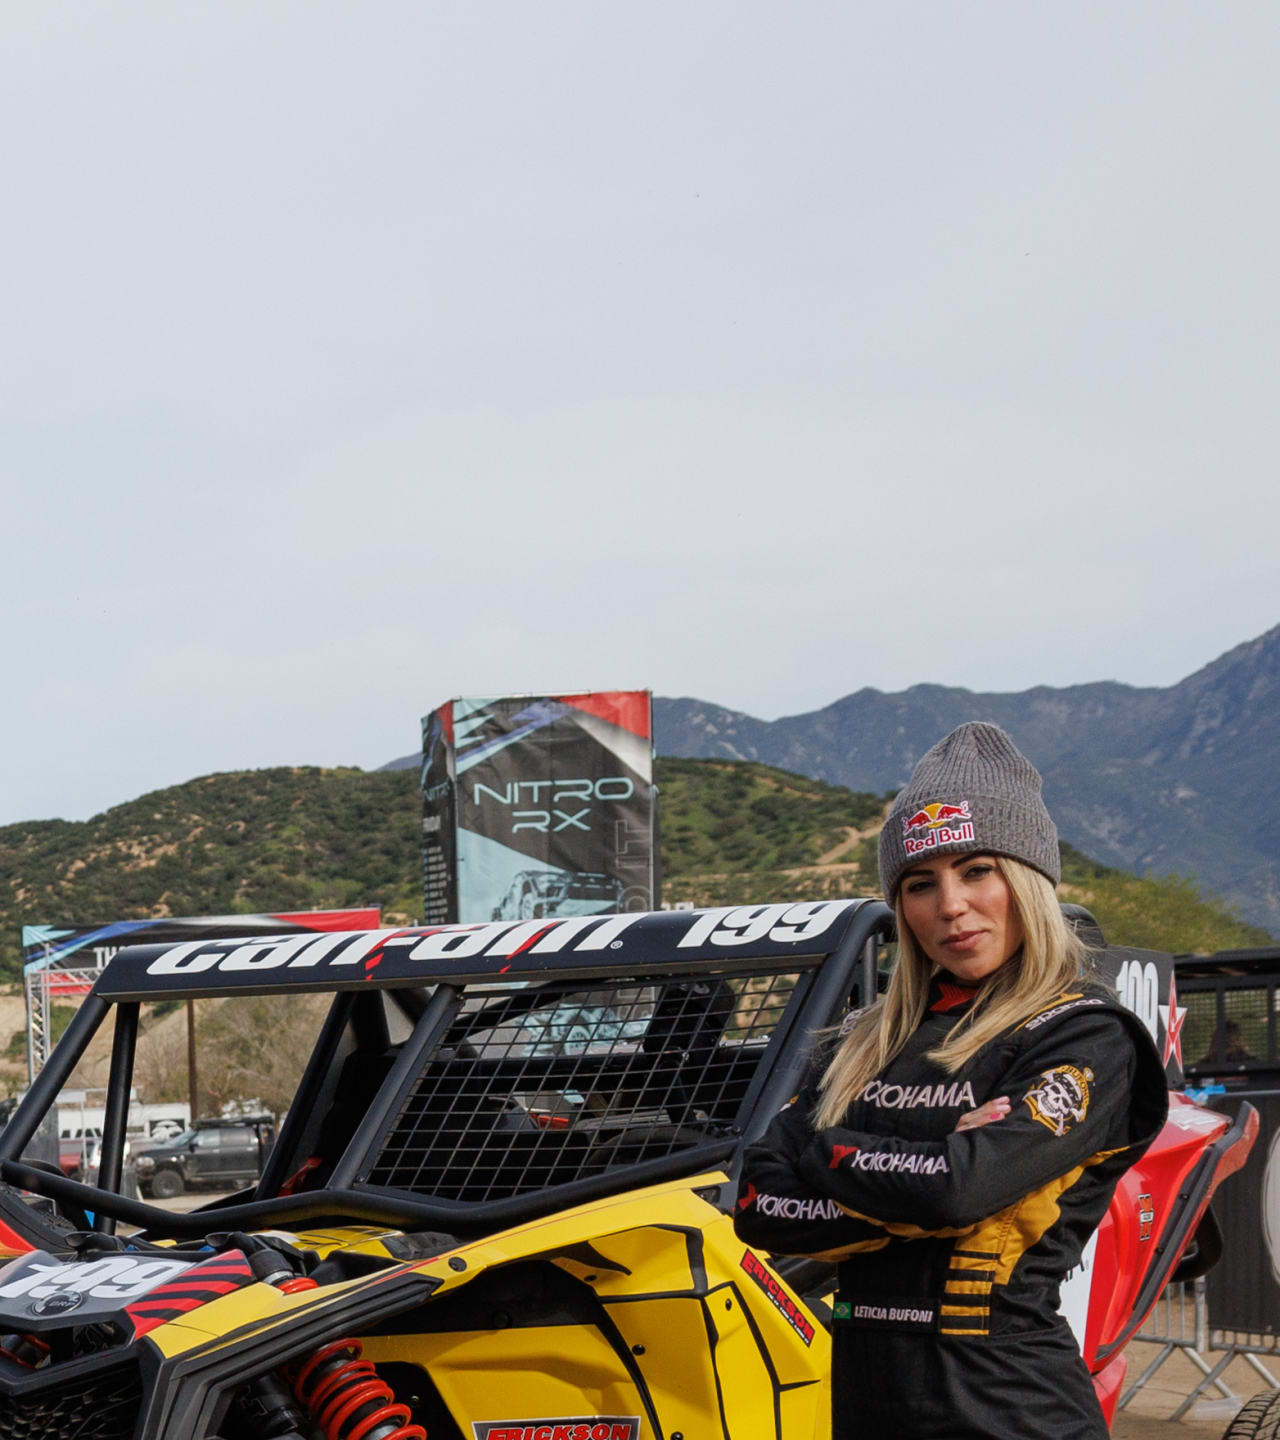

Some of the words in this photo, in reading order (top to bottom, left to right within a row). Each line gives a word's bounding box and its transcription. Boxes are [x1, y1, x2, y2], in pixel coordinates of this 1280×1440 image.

[473, 776, 634, 806] NITRO
[511, 807, 592, 834] RX
[903, 829, 938, 856] Red
[938, 822, 975, 845] Bull
[676, 900, 850, 948] 199
[1025, 998, 1107, 1031] sparco
[851, 1150, 950, 1175] YOKOHAMA
[756, 1193, 844, 1221] YOKOHAM
[741, 1250, 814, 1341] ERICKSON
[854, 1304, 888, 1320] LETICIA
[888, 1307, 934, 1323] BUFONI
